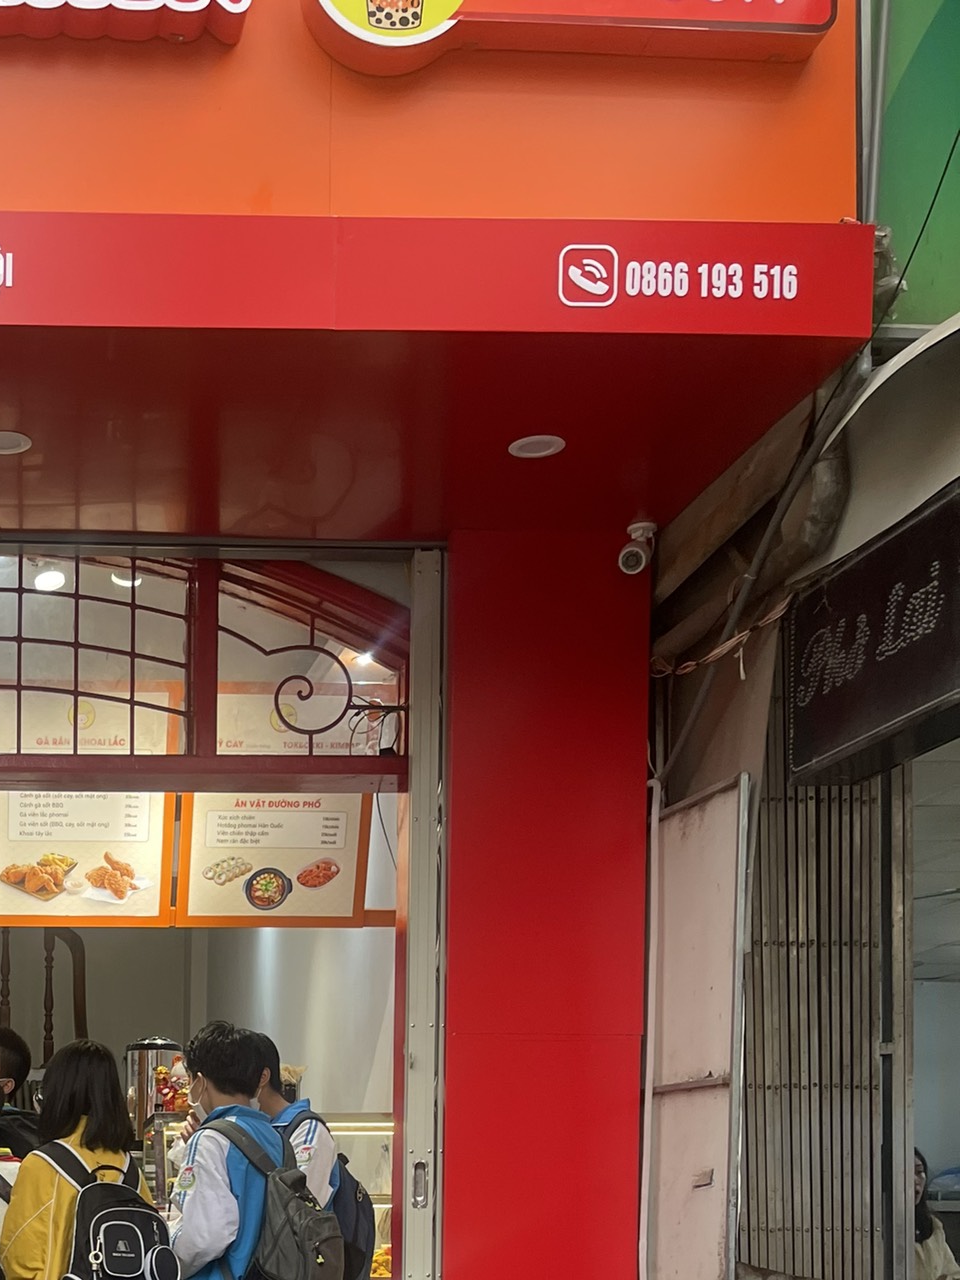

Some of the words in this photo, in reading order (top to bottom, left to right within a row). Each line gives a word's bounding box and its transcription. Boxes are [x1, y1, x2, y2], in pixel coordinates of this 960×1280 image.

[625, 260, 689, 298] 0866
[697, 262, 743, 299] 193
[752, 264, 798, 300] 516
[36, 736, 49, 746] GÀ
[108, 735, 126, 747] LẮC
[225, 740, 244, 749] CAY
[234, 798, 247, 809] ĂN
[249, 799, 266, 810] VẶT
[268, 799, 300, 809] ĐƯỜNG
[302, 797, 323, 809] PHỐ
